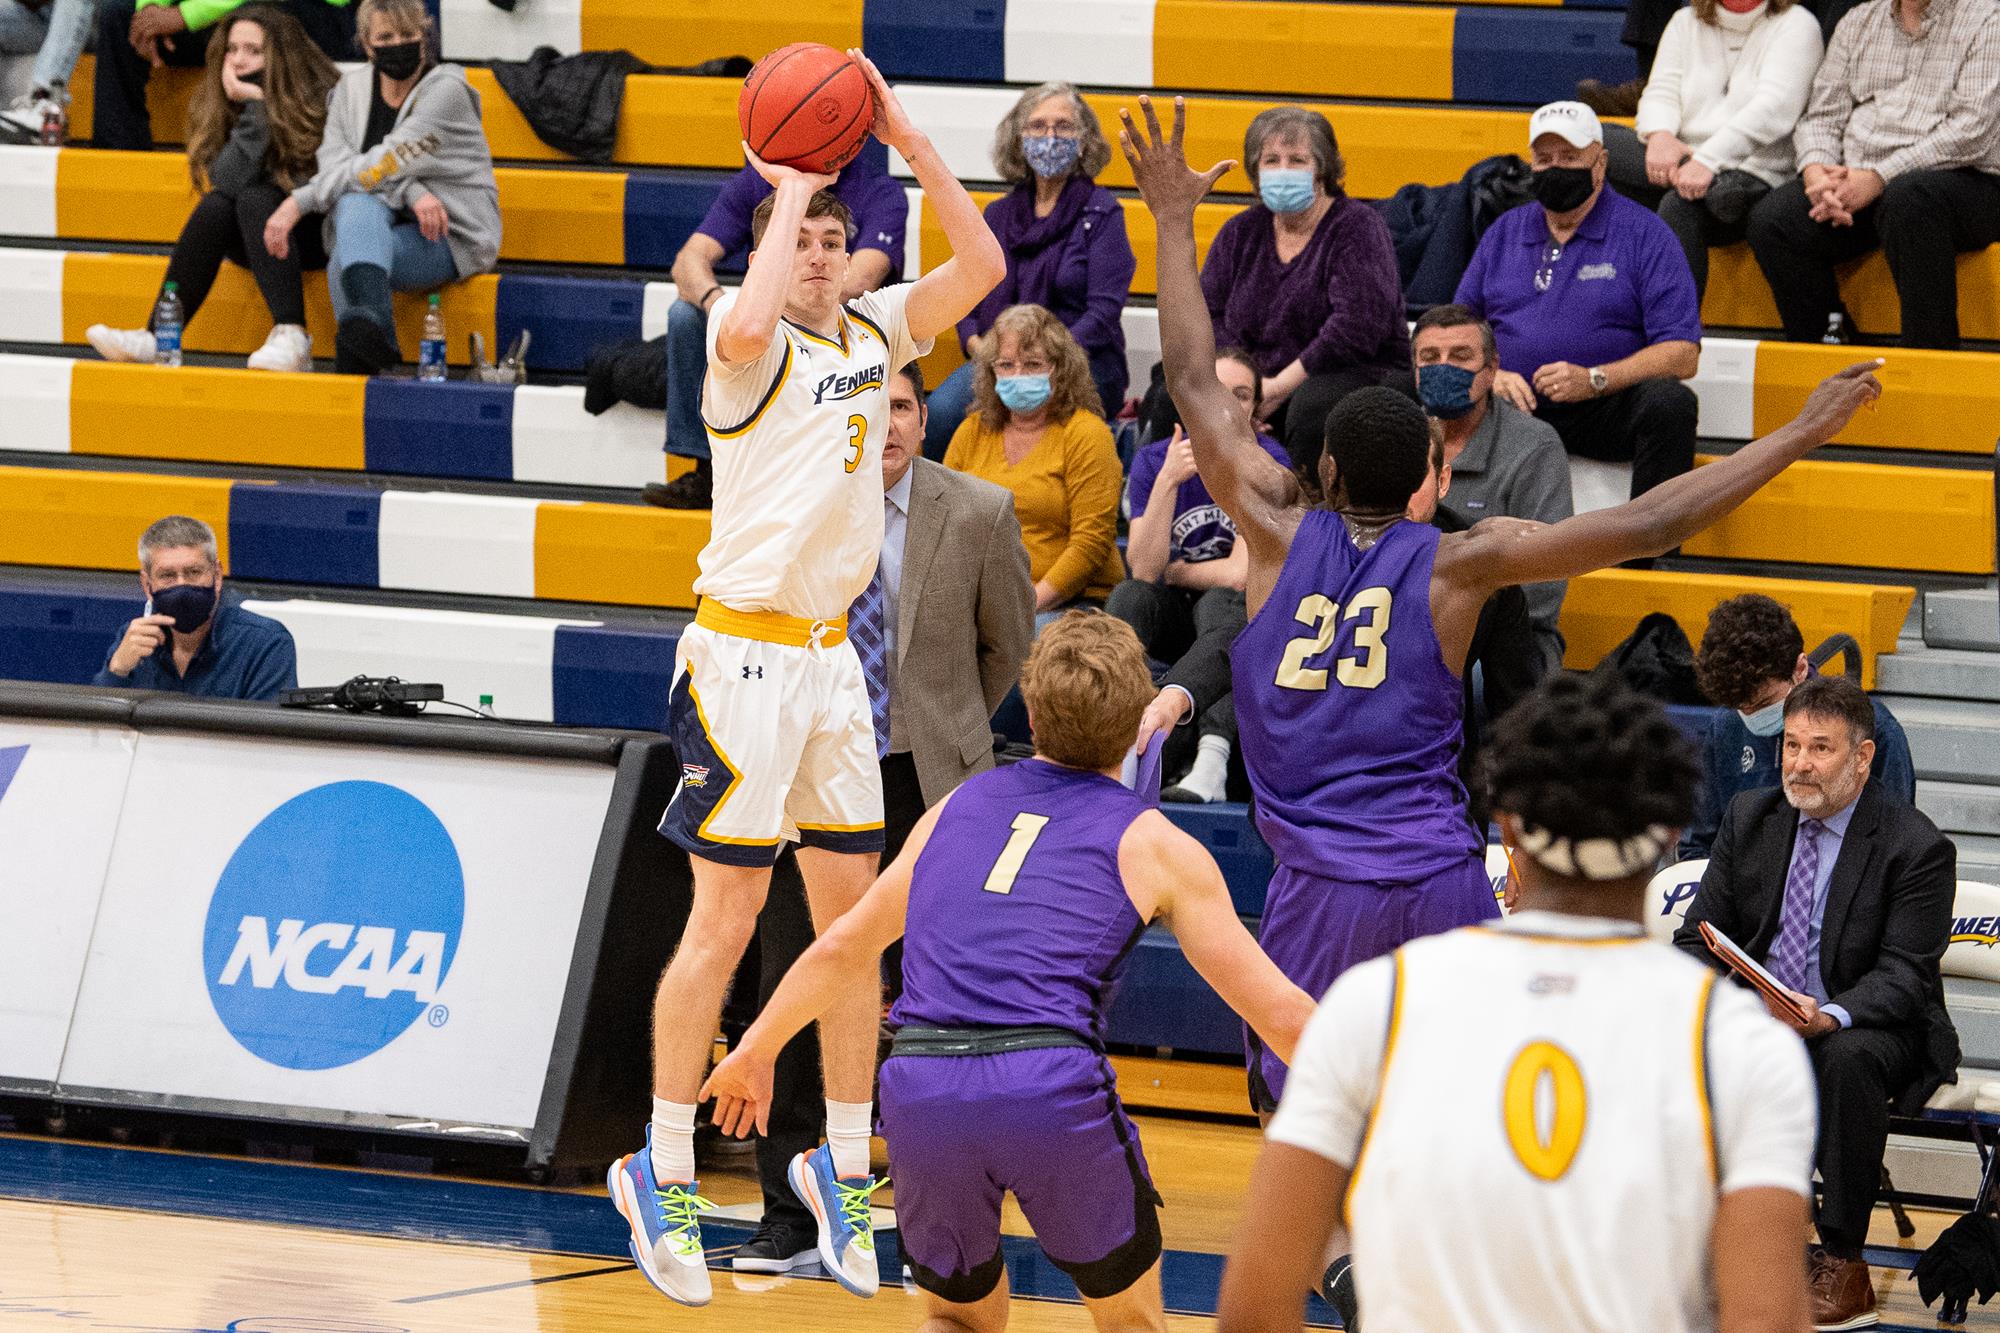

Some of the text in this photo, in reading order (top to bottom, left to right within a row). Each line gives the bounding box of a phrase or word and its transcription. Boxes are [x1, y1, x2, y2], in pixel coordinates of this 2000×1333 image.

[811, 362, 885, 405] PENMEN
[844, 413, 868, 474] 3
[1273, 585, 1393, 691] 23
[982, 811, 1051, 896] 1
[217, 915, 447, 1004] NCAA
[1503, 1039, 1588, 1182] 0
